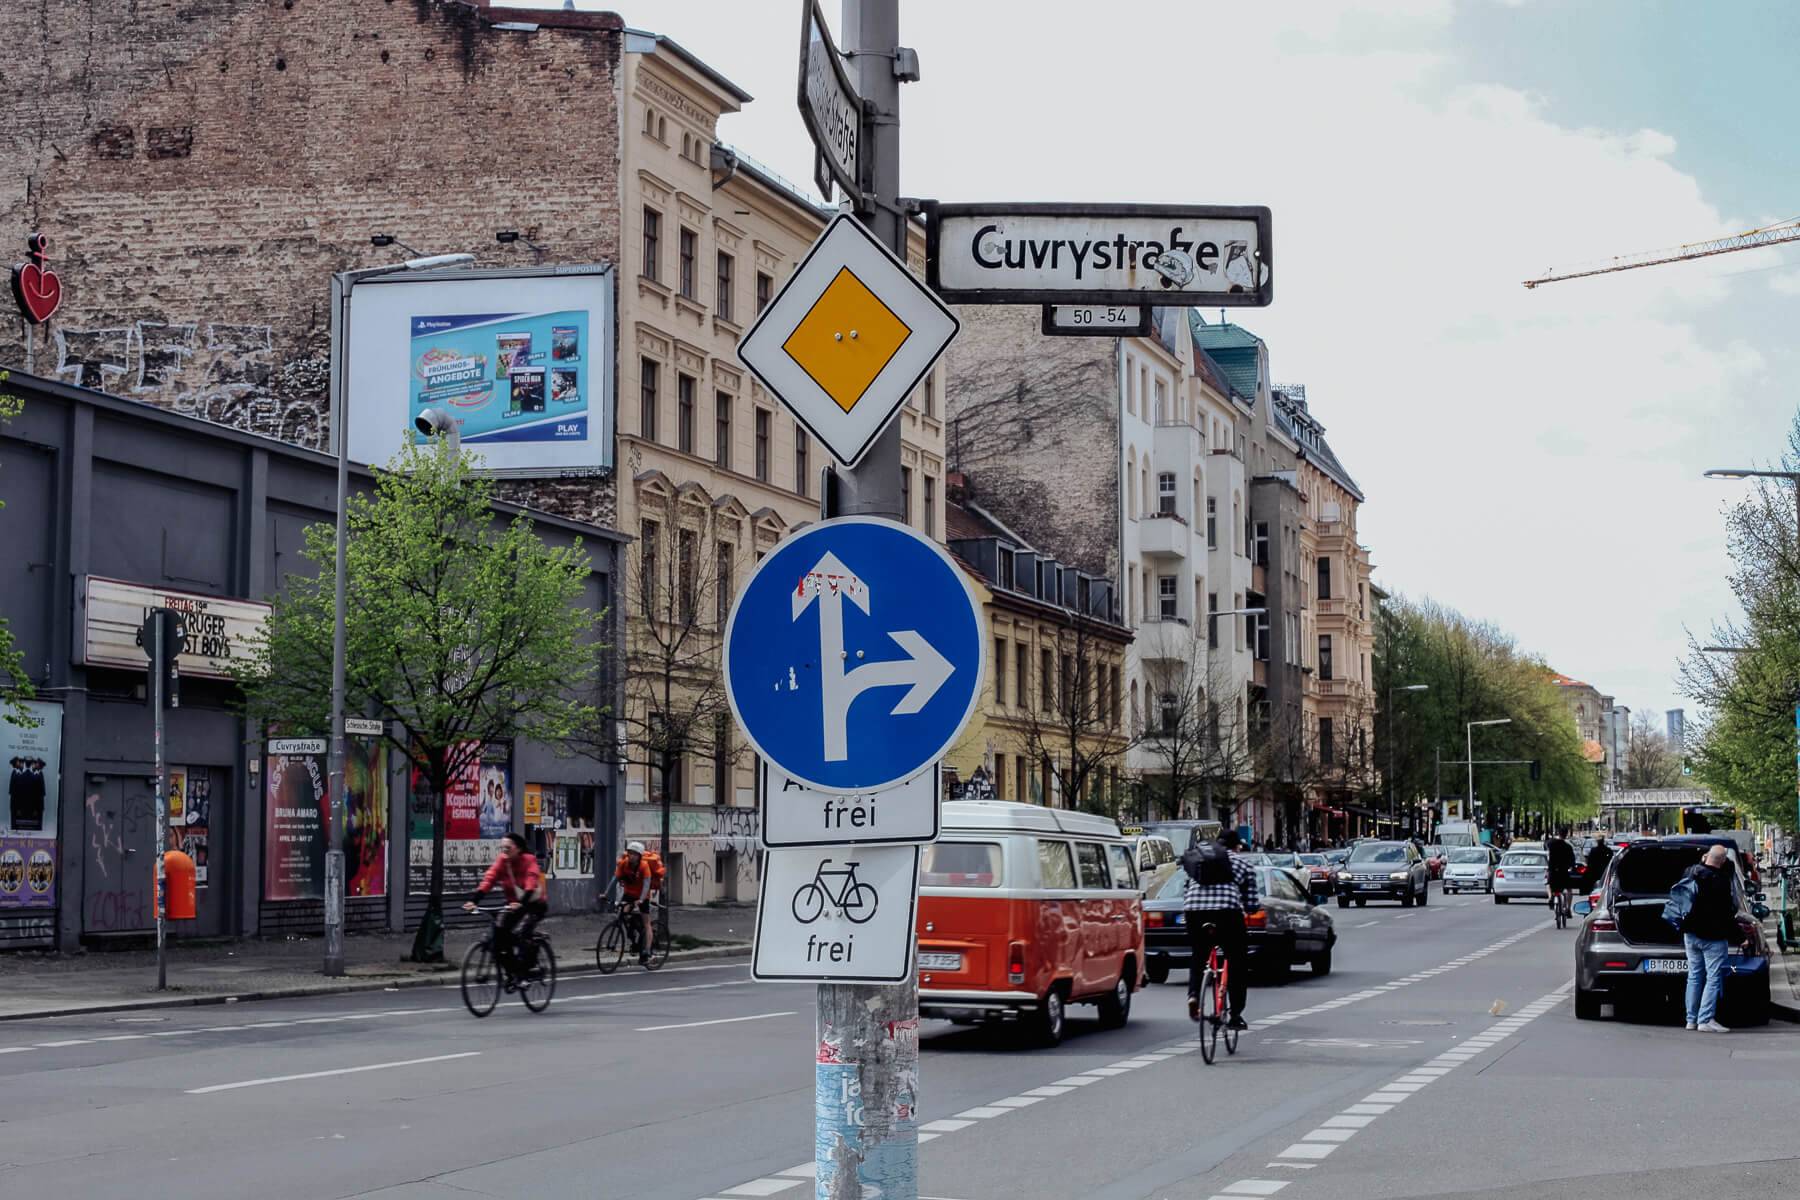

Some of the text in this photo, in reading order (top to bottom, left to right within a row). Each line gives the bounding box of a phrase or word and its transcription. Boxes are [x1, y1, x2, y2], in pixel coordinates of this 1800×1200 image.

[971, 225, 1219, 281] Cuvrystraße
[555, 264, 603, 275] SUPERPOSTER
[1073, 310, 1092, 325] 50
[429, 368, 482, 385] ANGEBOTE
[558, 424, 579, 433] PLAY
[165, 597, 194, 612] FREITAG
[202, 636, 230, 657] BOYS
[276, 740, 321, 753] Cuvrystraße
[296, 807, 318, 818] AMARO
[823, 798, 875, 828] frei
[807, 934, 853, 962] frei
